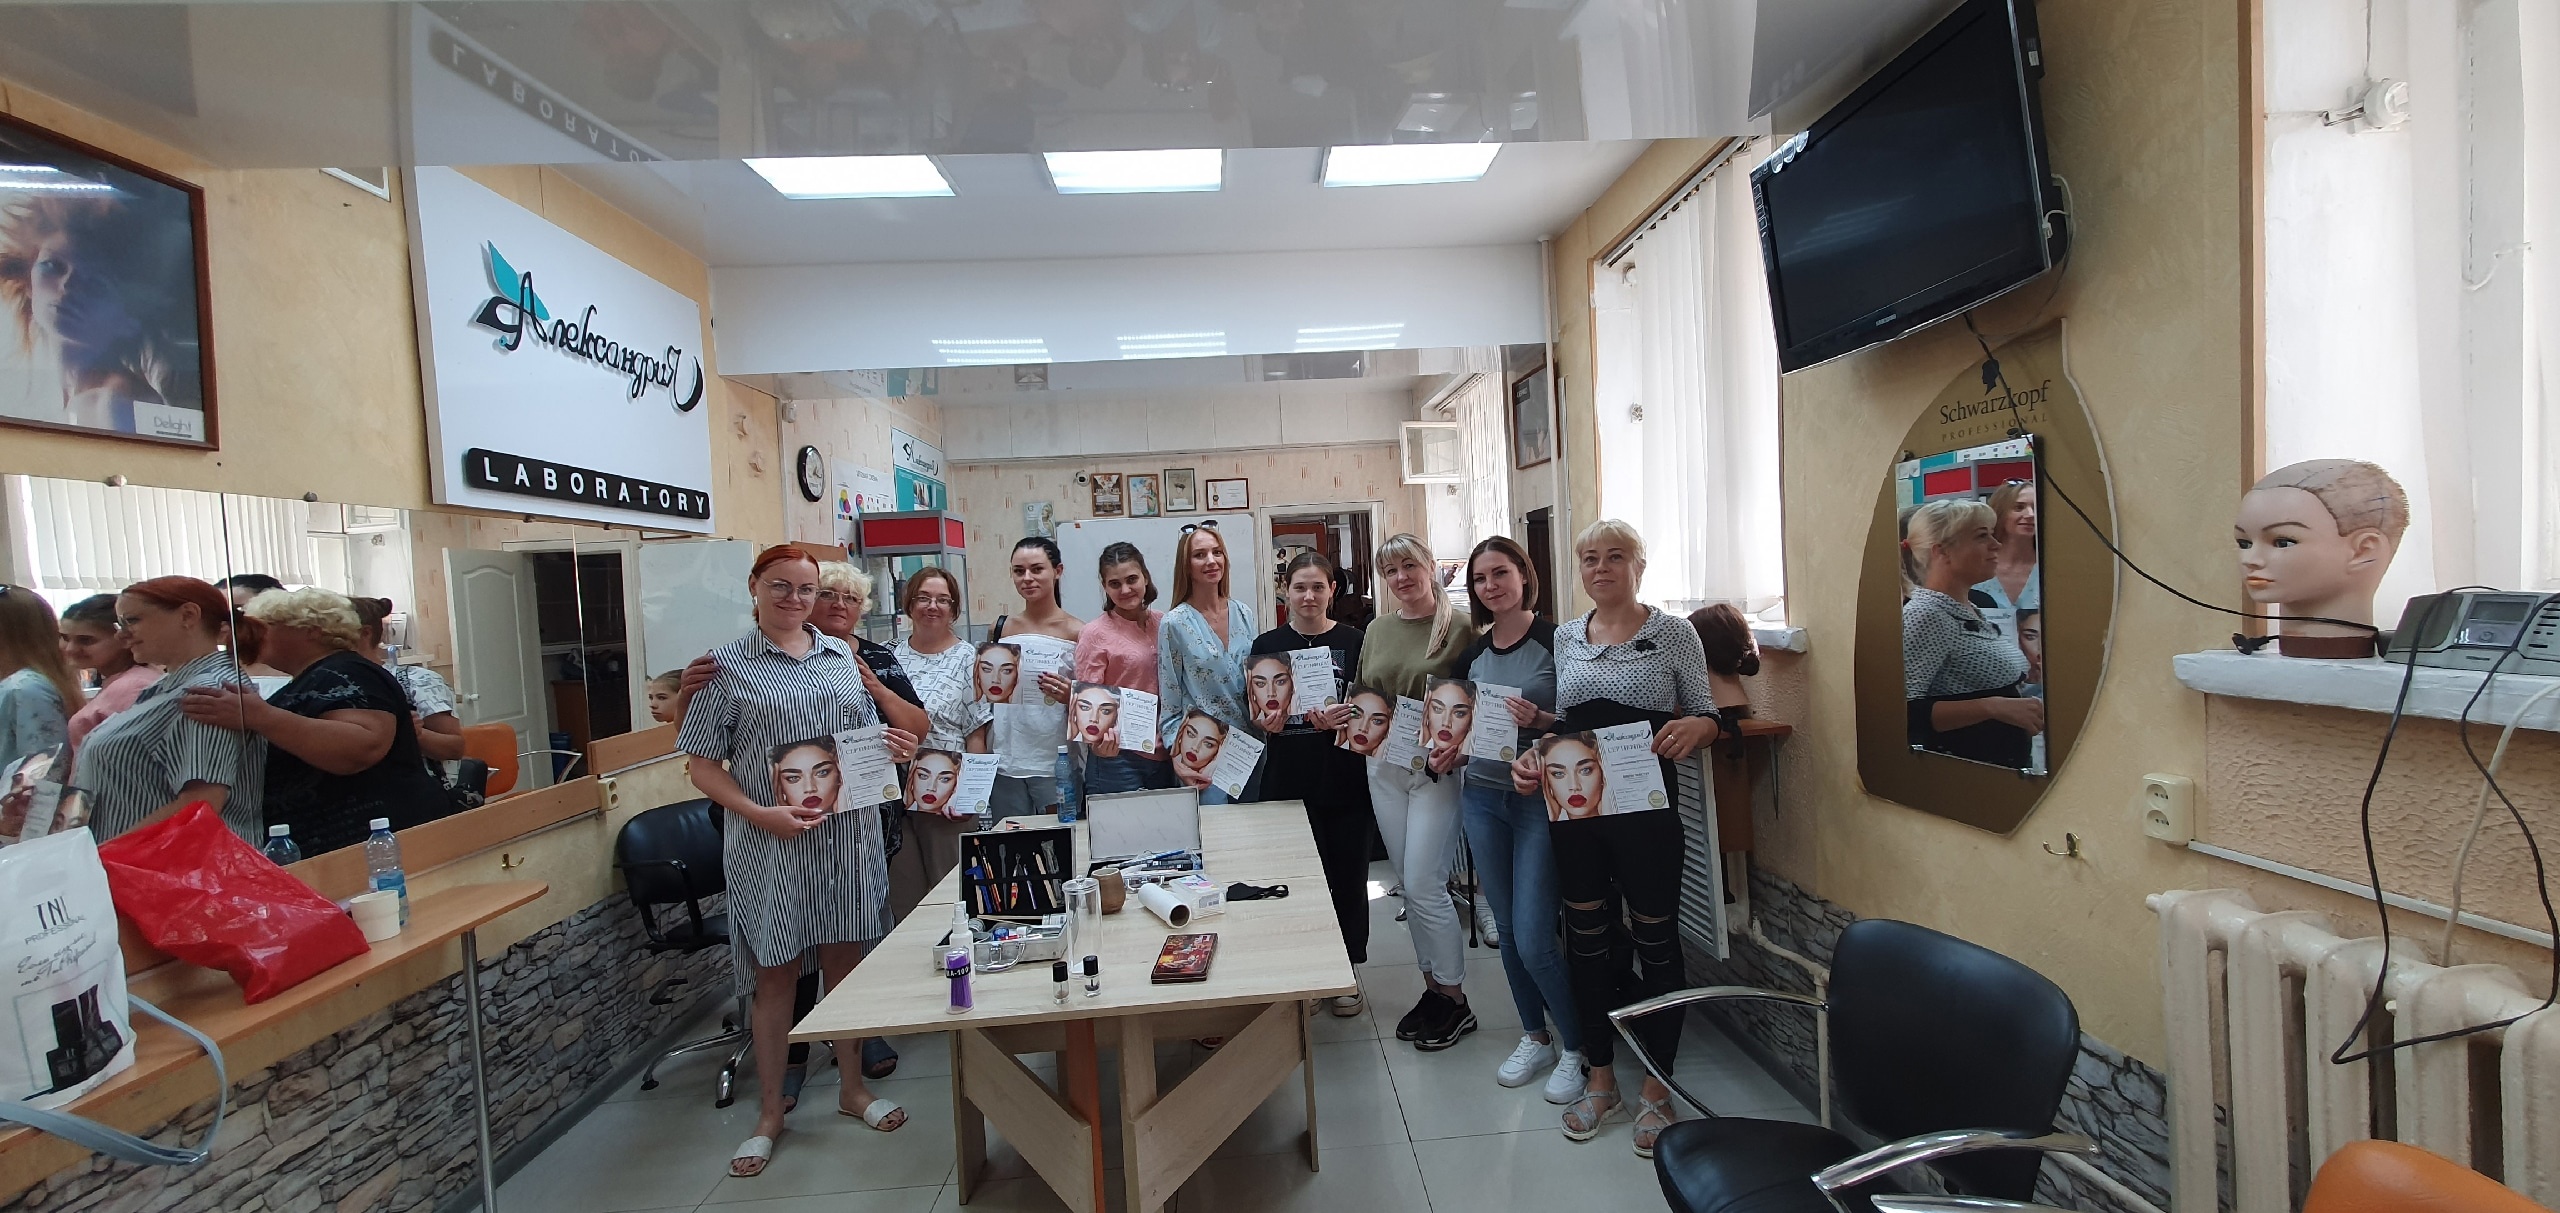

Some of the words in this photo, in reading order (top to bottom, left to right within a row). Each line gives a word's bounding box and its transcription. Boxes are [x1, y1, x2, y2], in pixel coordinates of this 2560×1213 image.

[476, 271, 704, 412] Александрия
[153, 414, 192, 434] Delight
[1940, 380, 2051, 425] Schwarzkopf
[483, 457, 705, 514] LABORATORY
